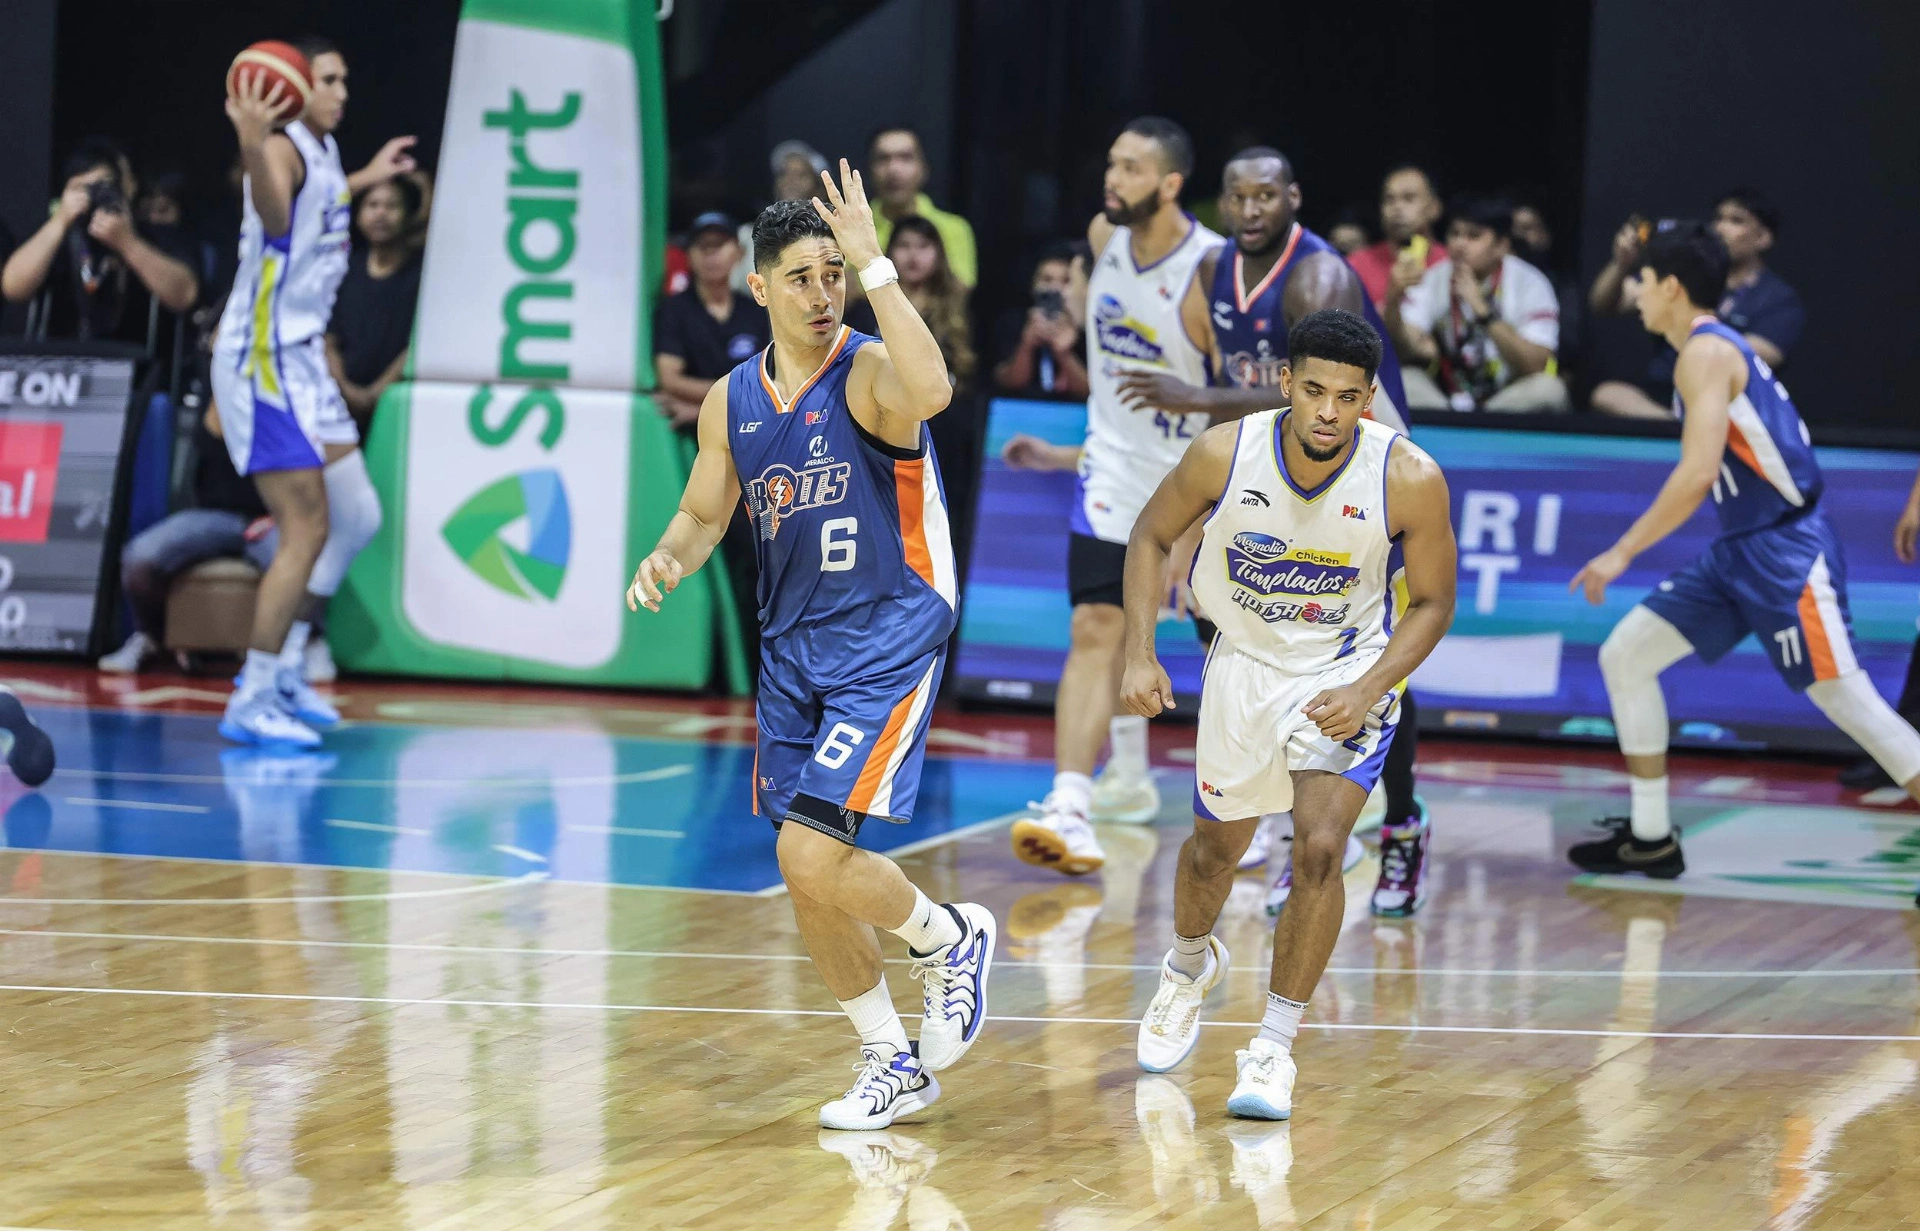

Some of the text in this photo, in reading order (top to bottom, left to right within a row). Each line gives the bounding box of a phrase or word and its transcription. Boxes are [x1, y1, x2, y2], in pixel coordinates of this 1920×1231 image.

[467, 88, 583, 453] Smart
[21, 370, 81, 406] ON
[804, 456, 835, 468] MERALCO
[749, 462, 851, 518] BOLTS
[1240, 497, 1259, 507] ANTA
[1342, 504, 1366, 520] PBA
[820, 517, 857, 572] 6
[1233, 534, 1286, 554] Magnolia
[1296, 551, 1339, 565] Chicken
[1233, 559, 1343, 594] Timplados
[1334, 627, 1359, 660] 2
[814, 722, 864, 770] 6
[1202, 780, 1224, 798] PBA
